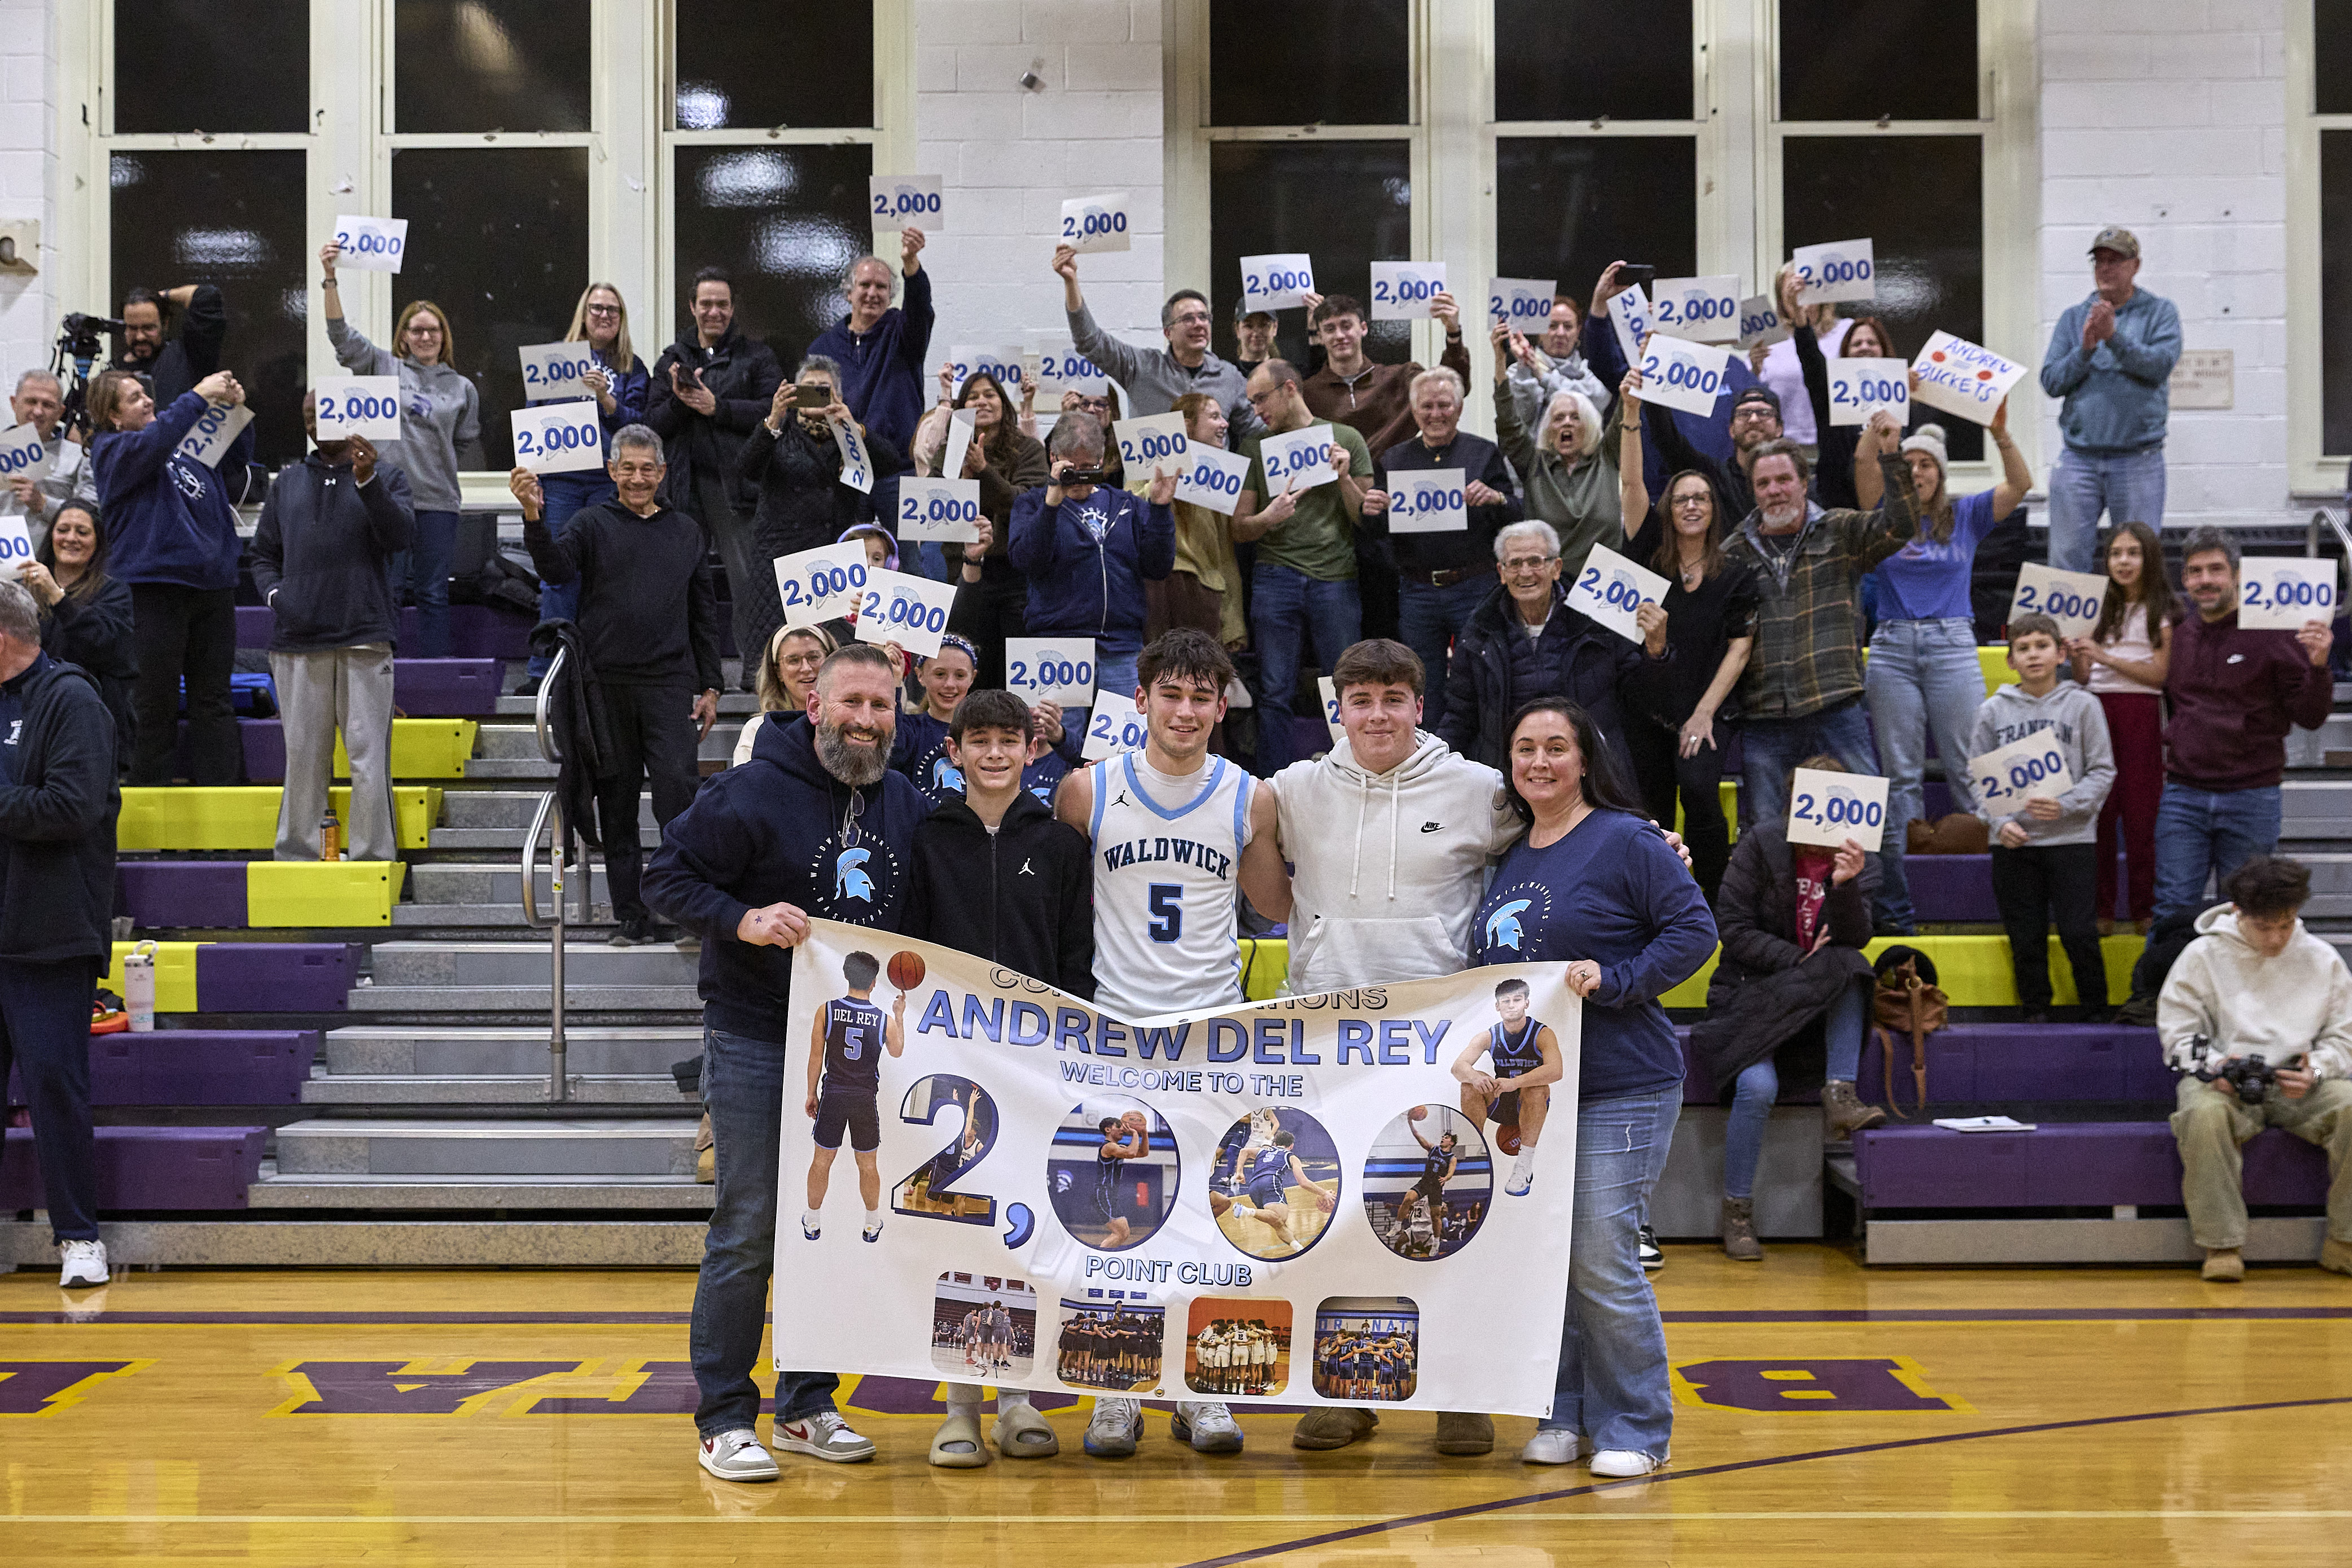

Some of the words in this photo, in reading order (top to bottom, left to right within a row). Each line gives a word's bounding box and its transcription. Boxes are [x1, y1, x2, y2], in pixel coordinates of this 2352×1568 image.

[875, 194, 940, 216] 2,000
[1063, 213, 1125, 237] 2,000
[338, 233, 400, 253] 2,000
[1247, 272, 1310, 295] 2,000
[1799, 260, 1870, 286] 2,000
[1375, 281, 1443, 304] 2,000
[1491, 297, 1551, 318] 2,000
[1659, 298, 1734, 324] 2,000
[1943, 339, 2013, 374] ANDREW
[527, 360, 589, 384] 2,000
[1642, 356, 1717, 393] 2,000
[1916, 361, 1998, 402] BUCKETS
[1834, 380, 1906, 406] 2,000
[321, 397, 396, 422] 2,000
[518, 424, 597, 455] 2,000
[1122, 433, 1185, 462] 2,000
[1267, 444, 1329, 476] 2,000
[1180, 465, 1240, 494] ,000
[903, 498, 976, 523] 2,000
[1392, 489, 1462, 515] 2,000
[784, 564, 866, 605] 2,000
[1579, 568, 1654, 612] 2,00
[2245, 582, 2331, 608] 2,000
[862, 592, 944, 632] 2,000
[2018, 587, 2097, 618] 2,000
[1010, 662, 1091, 689] 2,000
[1983, 752, 2061, 797] 2,000
[1795, 794, 1881, 826] 2,000
[1425, 821, 1440, 830] NIKE
[1104, 838, 1231, 881] WALDWICK
[1148, 883, 1184, 944] 5
[833, 1009, 853, 1023] DEL
[856, 1011, 879, 1027] REY
[917, 989, 1189, 1062] ANDREW
[1207, 1018, 1321, 1065] DEL
[1337, 1019, 1452, 1065] REY
[844, 1027, 864, 1061] 5
[1059, 1060, 1202, 1093] WELCOME
[1207, 1071, 1245, 1094] TO
[1250, 1073, 1304, 1097] THE
[1085, 1255, 1172, 1282] POINT
[1177, 1262, 1252, 1287] CLUB
